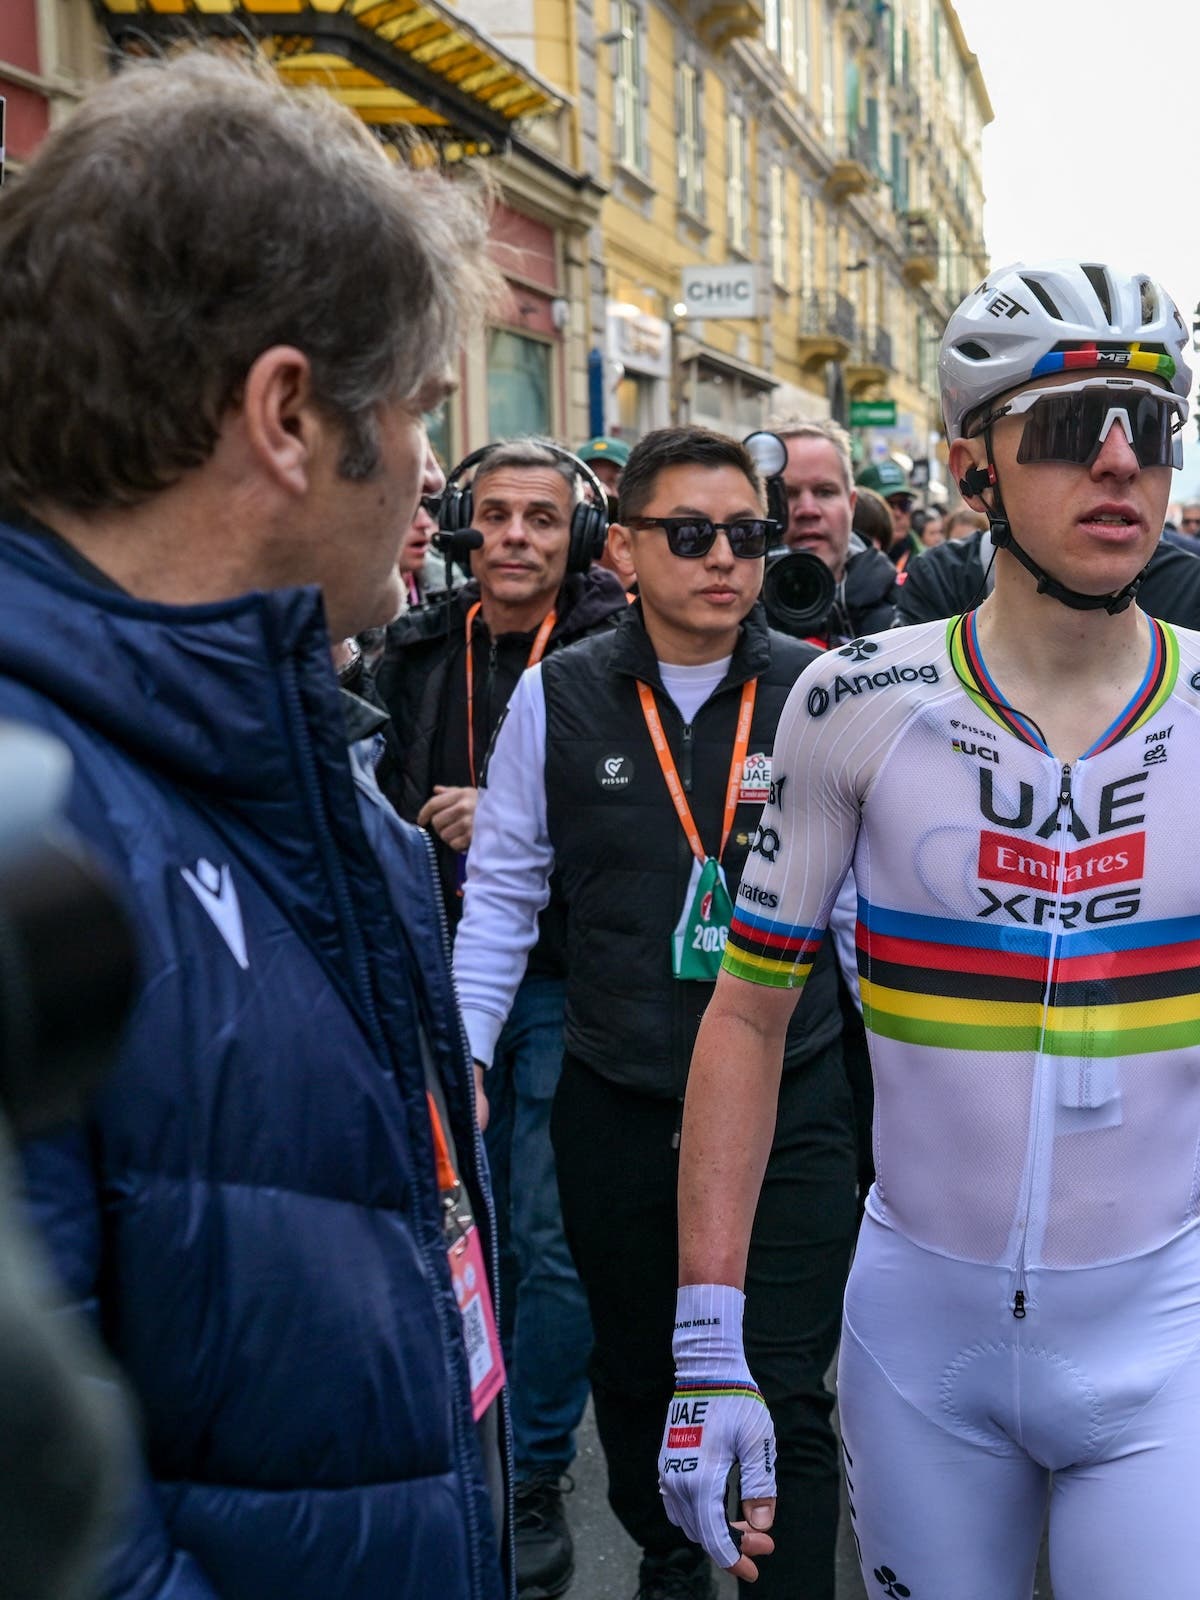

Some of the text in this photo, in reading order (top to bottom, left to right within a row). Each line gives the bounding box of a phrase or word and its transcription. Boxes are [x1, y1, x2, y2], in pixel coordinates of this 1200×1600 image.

[687, 281, 749, 300] CHIC
[974, 281, 1029, 319] MET
[833, 664, 940, 703] Analog
[961, 723, 996, 741] PISSEI
[960, 740, 999, 764] UCI
[601, 776, 629, 785] PISSEI
[742, 770, 771, 781] UAE
[979, 767, 1149, 842] UAE
[996, 846, 1129, 882] Emirates
[977, 888, 1141, 929] XRG
[671, 1401, 709, 1425] UAE
